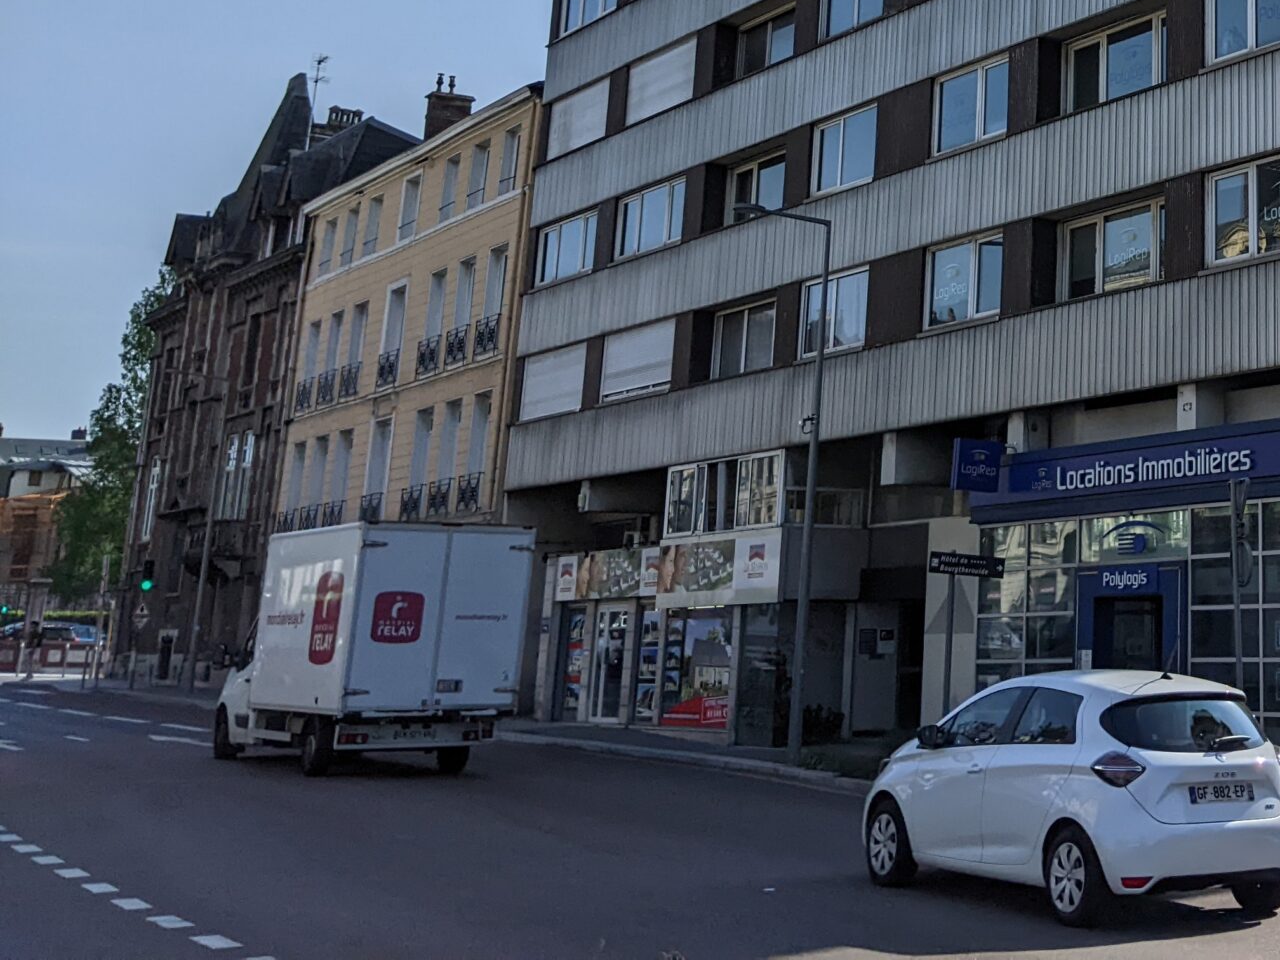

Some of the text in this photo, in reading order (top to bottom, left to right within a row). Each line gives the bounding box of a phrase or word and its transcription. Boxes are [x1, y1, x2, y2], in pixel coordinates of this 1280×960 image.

[1108, 246, 1148, 269] LogiRep
[961, 461, 997, 477] LogiRep
[1056, 447, 1251, 490] Locations Immobilières
[940, 554, 959, 563] Hôtel
[1102, 569, 1148, 589] Polylogis
